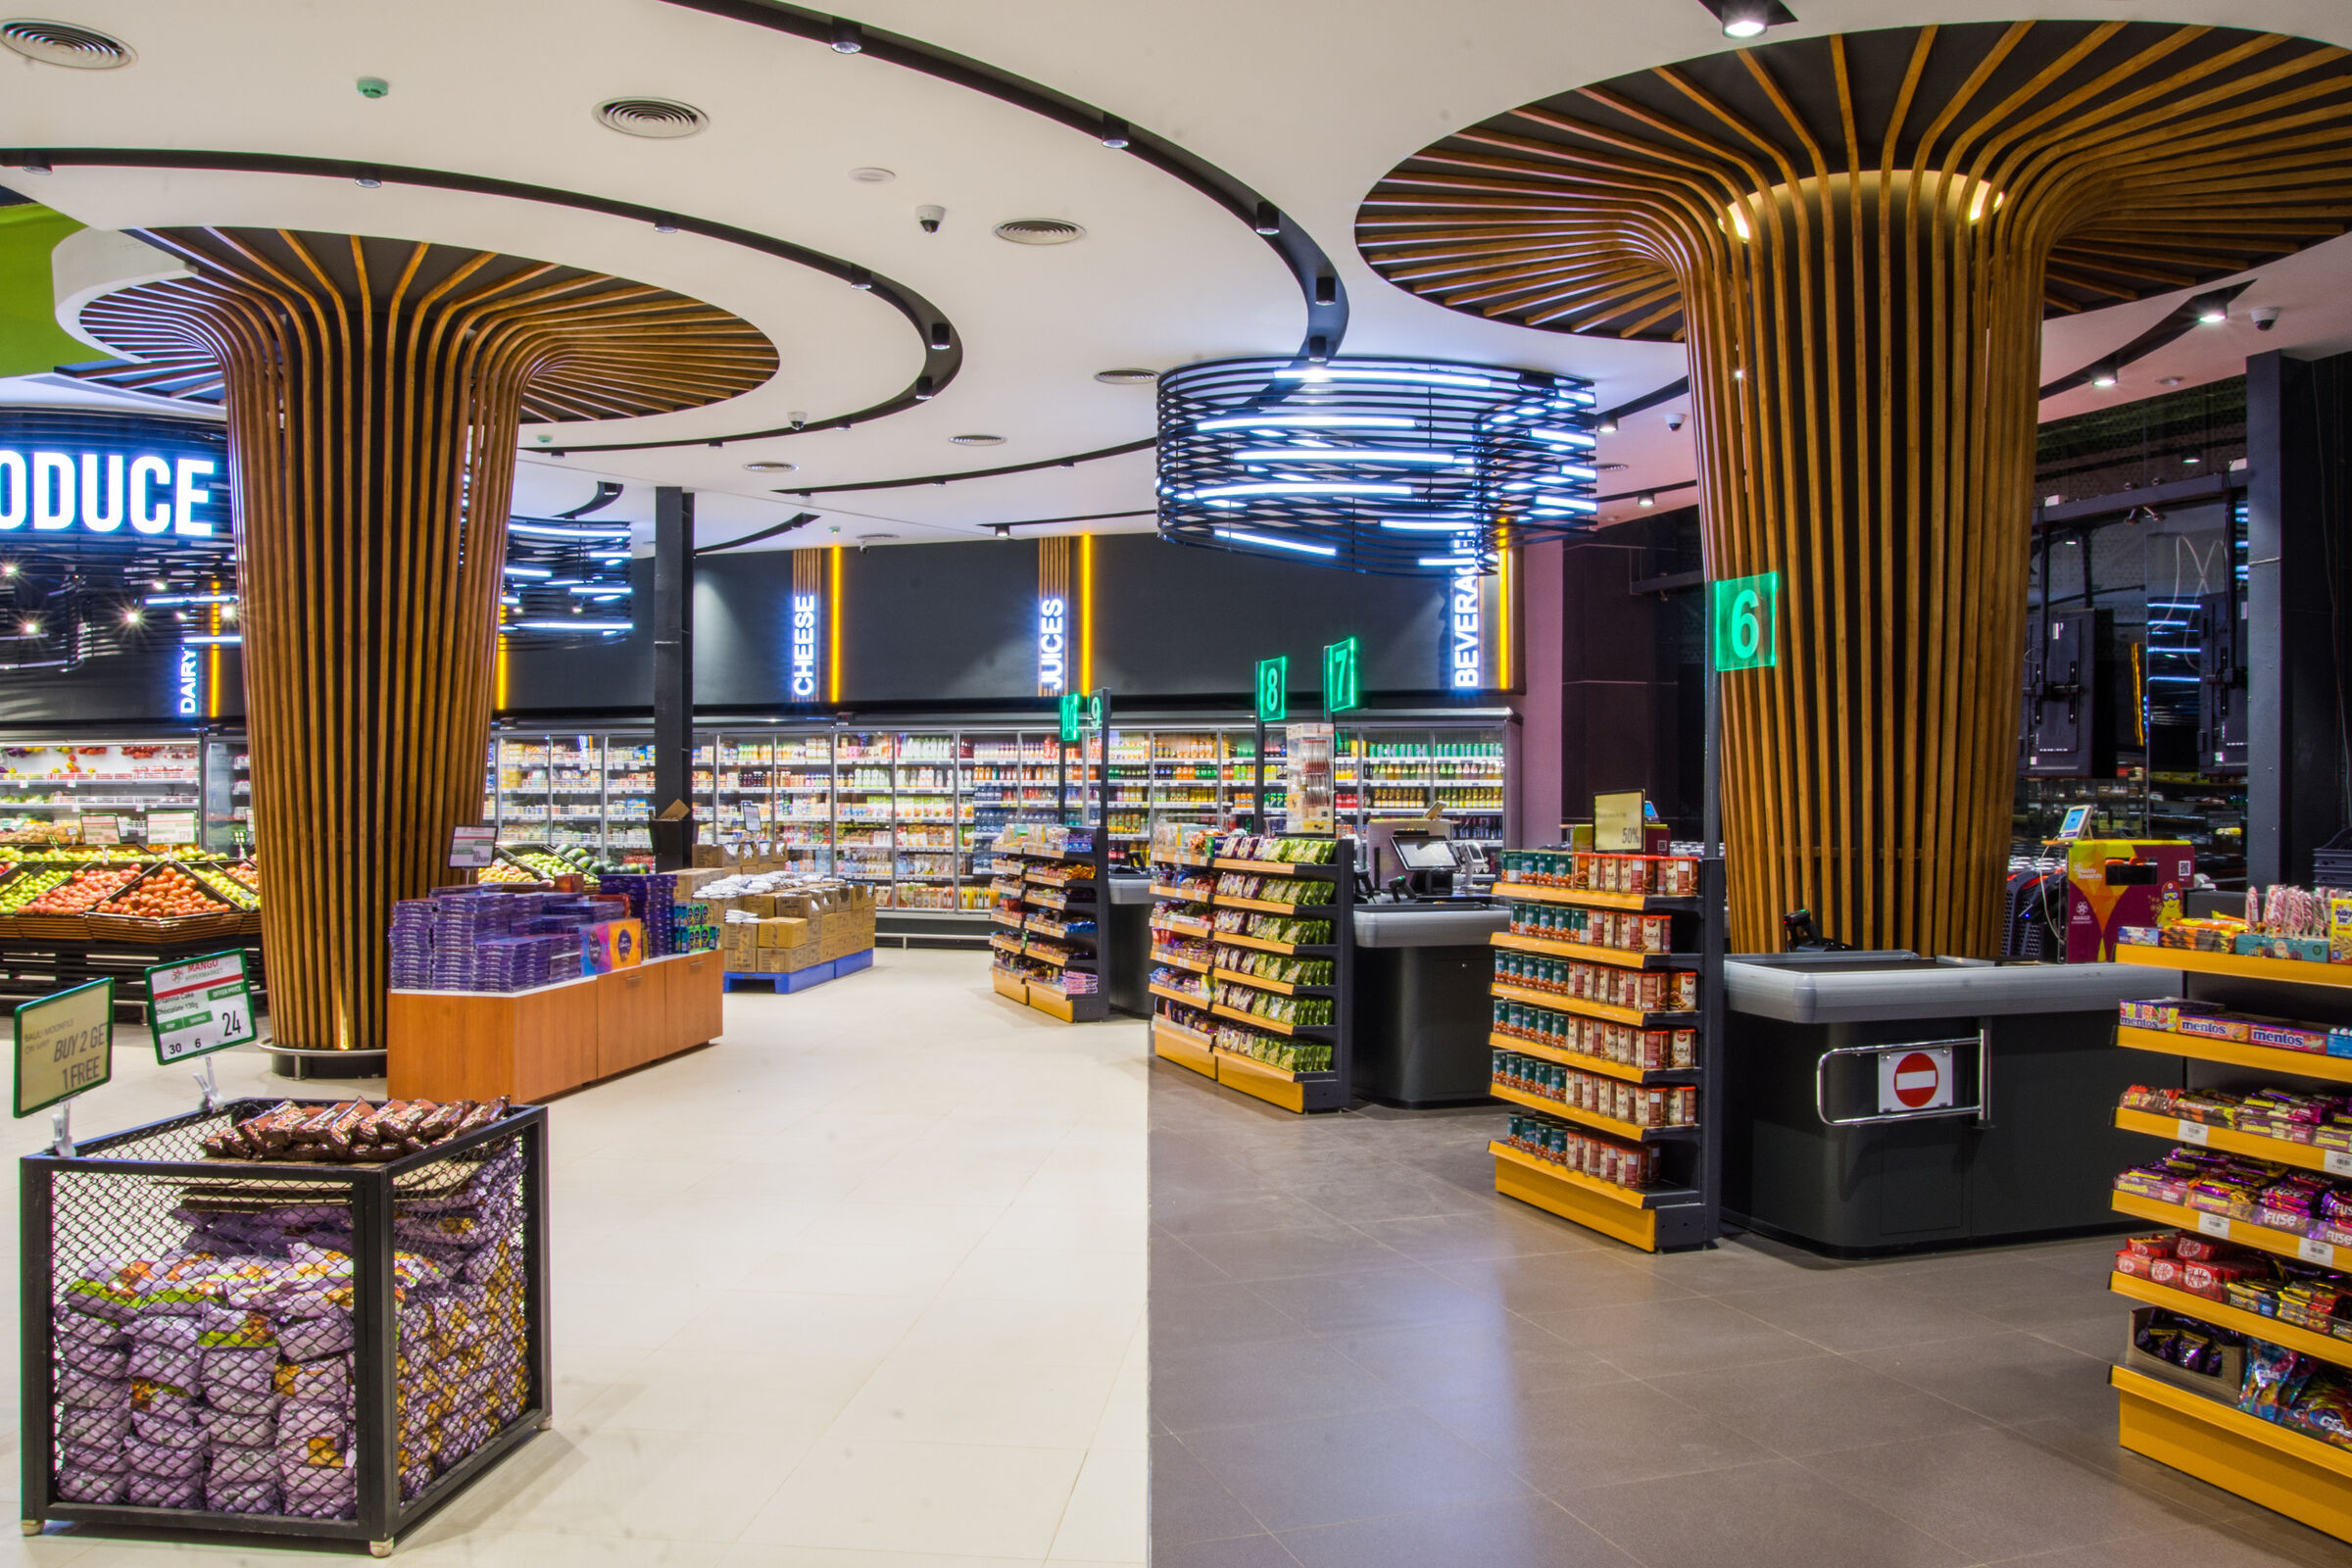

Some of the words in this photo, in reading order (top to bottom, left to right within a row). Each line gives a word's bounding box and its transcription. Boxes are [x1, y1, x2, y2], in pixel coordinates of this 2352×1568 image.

[0, 450, 215, 537] ODUCE
[1454, 527, 1479, 687] BEVERAE
[1732, 589, 1759, 659] 6
[794, 595, 814, 696] CHEESE
[1041, 598, 1063, 690] JUICES
[180, 648, 197, 714] DAIRY
[1266, 667, 1278, 711] 8
[1335, 649, 1348, 702] 7
[1091, 697, 1102, 730] 9
[1622, 827, 1641, 844] 50%
[187, 959, 219, 973] MANGO
[221, 1010, 242, 1037] 24
[2121, 1016, 2159, 1030] mentos
[2181, 1019, 2227, 1035] mentos
[2253, 1029, 2304, 1047] mentos
[54, 1033, 78, 1062] BUY
[79, 1030, 87, 1053] 2
[90, 1022, 108, 1049] GE
[169, 1043, 182, 1054] 30
[194, 1038, 202, 1049] 6
[63, 1068, 69, 1090] 1
[71, 1055, 101, 1088] FREE
[2334, 1202, 2352, 1215] FUS
